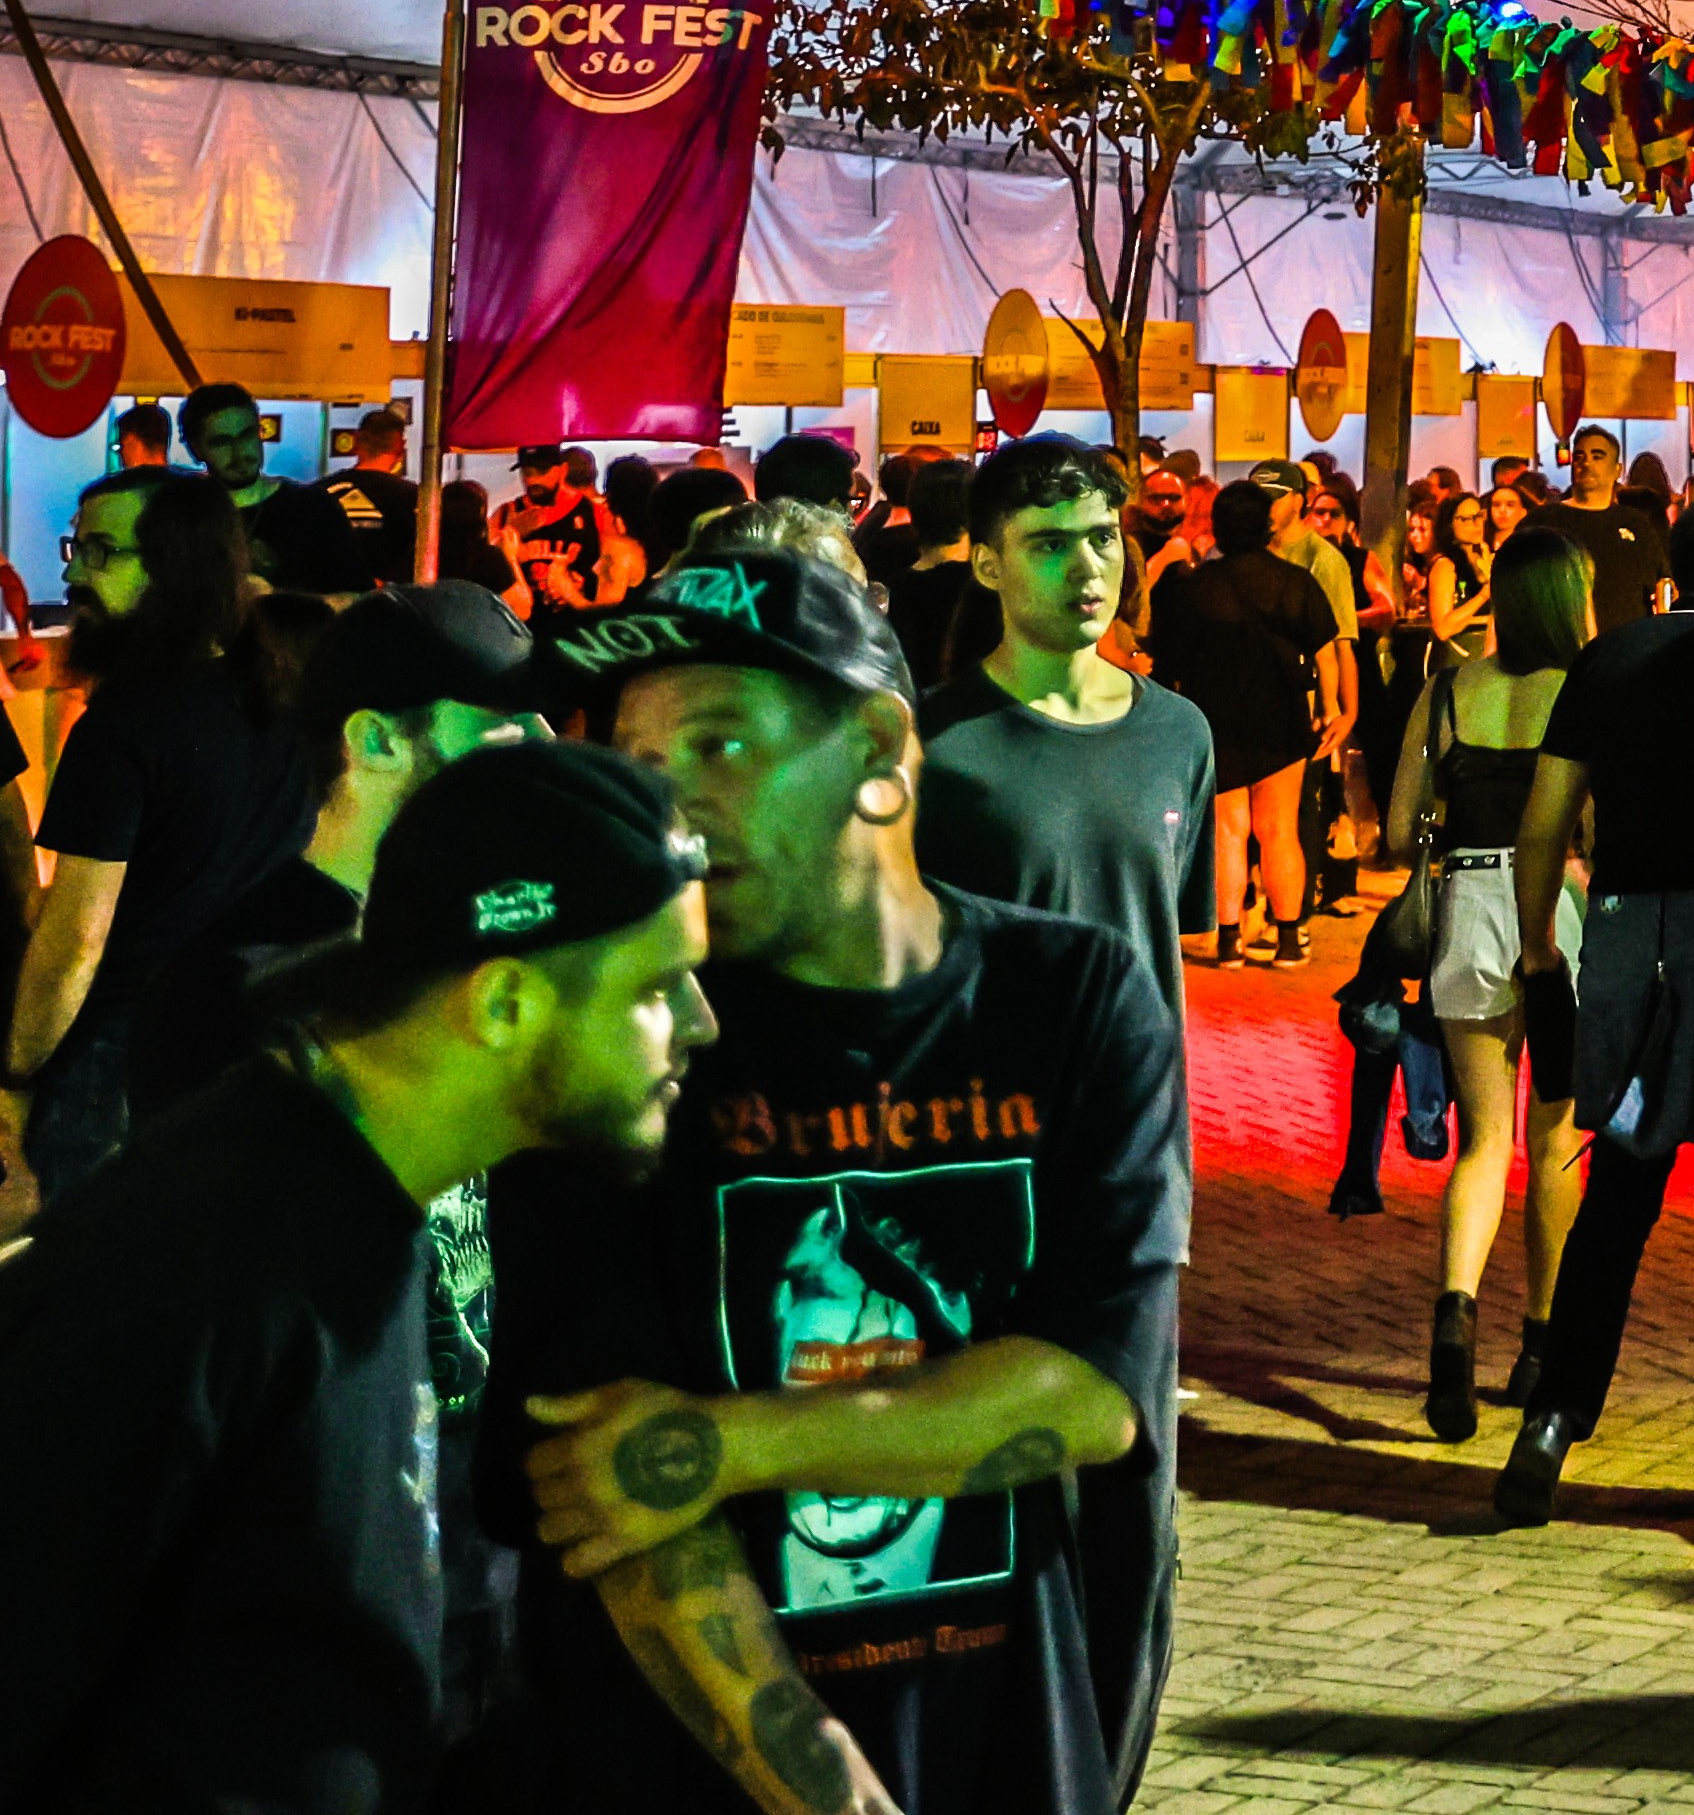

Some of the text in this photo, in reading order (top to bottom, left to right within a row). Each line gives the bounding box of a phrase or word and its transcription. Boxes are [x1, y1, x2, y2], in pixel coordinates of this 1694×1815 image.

[476, 3, 763, 51] ROCK FEST
[8, 325, 118, 353] ROCK FEST
[911, 420, 941, 436] CAIXA
[554, 614, 692, 673] NOT
[709, 1077, 1041, 1165] Brujeria
